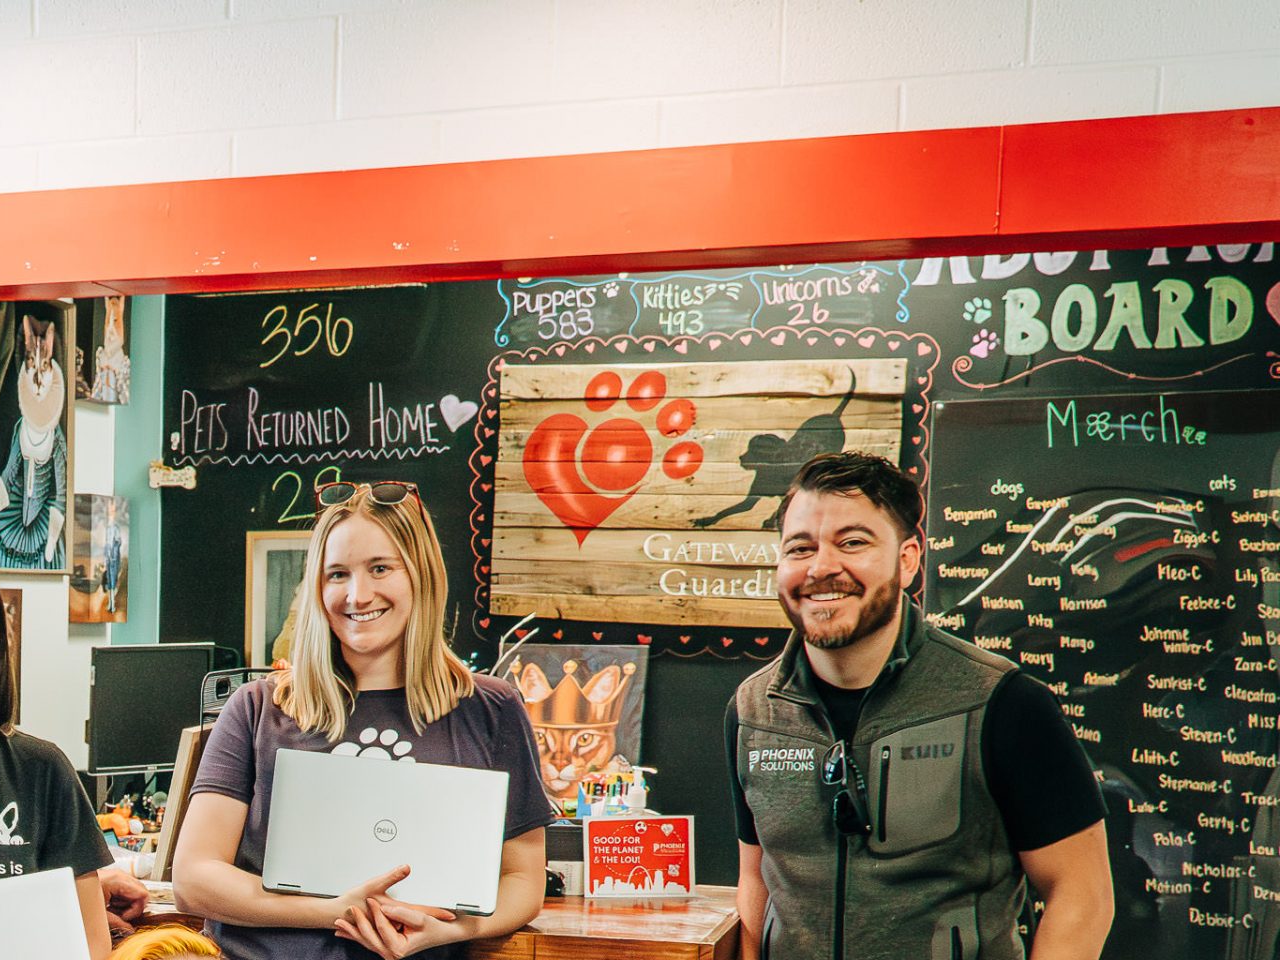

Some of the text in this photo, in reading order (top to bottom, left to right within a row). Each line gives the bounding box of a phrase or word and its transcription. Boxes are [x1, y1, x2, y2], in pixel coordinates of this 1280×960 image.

[642, 281, 706, 309] Kitties
[762, 273, 853, 306] Unicorns
[511, 285, 598, 317] Puppers
[659, 309, 704, 336] 493
[786, 301, 830, 327] 26
[1002, 275, 1254, 356] BOARD
[537, 309, 595, 340] 583
[259, 302, 353, 368] 356
[247, 386, 350, 450] RETURNED
[369, 382, 440, 449] HOME
[990, 479, 1024, 501] dogs
[1209, 475, 1237, 491] cats
[944, 507, 997, 526] Benjamin
[938, 564, 989, 580] Buttercup
[1158, 563, 1202, 581] Kleo-C
[1235, 568, 1258, 587] Lily
[659, 568, 779, 597] Guardi
[1241, 631, 1262, 647] Jim
[1180, 725, 1237, 744] Steven-C
[761, 748, 815, 760] PHOENIX
[760, 761, 815, 772] SOLUTIONS
[1159, 773, 1232, 794] Stephanie-C
[377, 827, 395, 835] DELL
[593, 836, 640, 844] GOOD FOR
[593, 846, 609, 854] THE
[10, 861, 24, 875] is
[593, 856, 600, 864] &
[620, 856, 641, 864] LOU!
